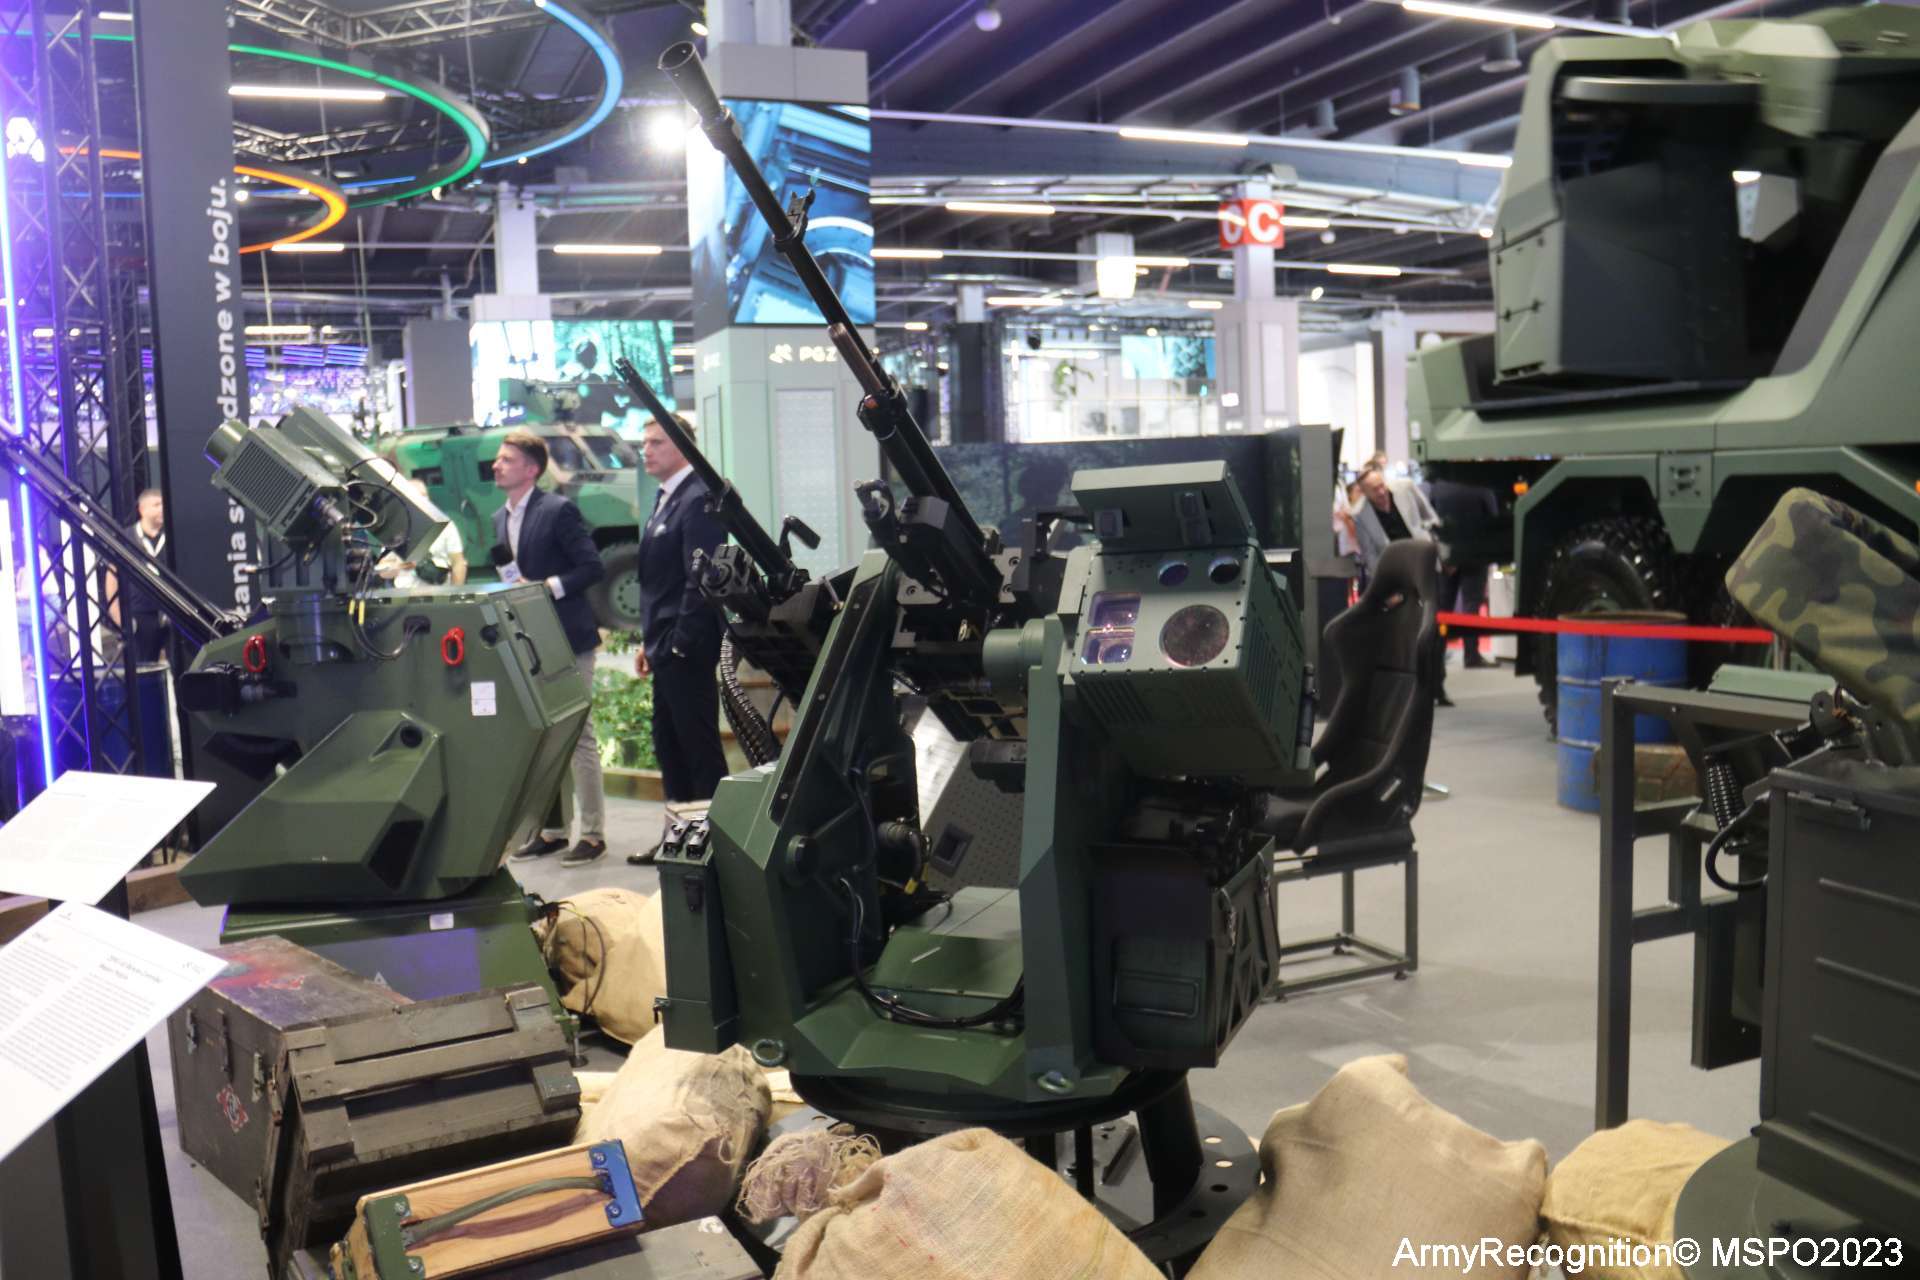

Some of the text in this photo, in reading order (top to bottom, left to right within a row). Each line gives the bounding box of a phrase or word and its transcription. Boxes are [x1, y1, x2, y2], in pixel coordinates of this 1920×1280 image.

[206, 178, 233, 265] boju.
[1247, 202, 1280, 243] C
[214, 272, 231, 303] w
[800, 346, 837, 362] PGZ
